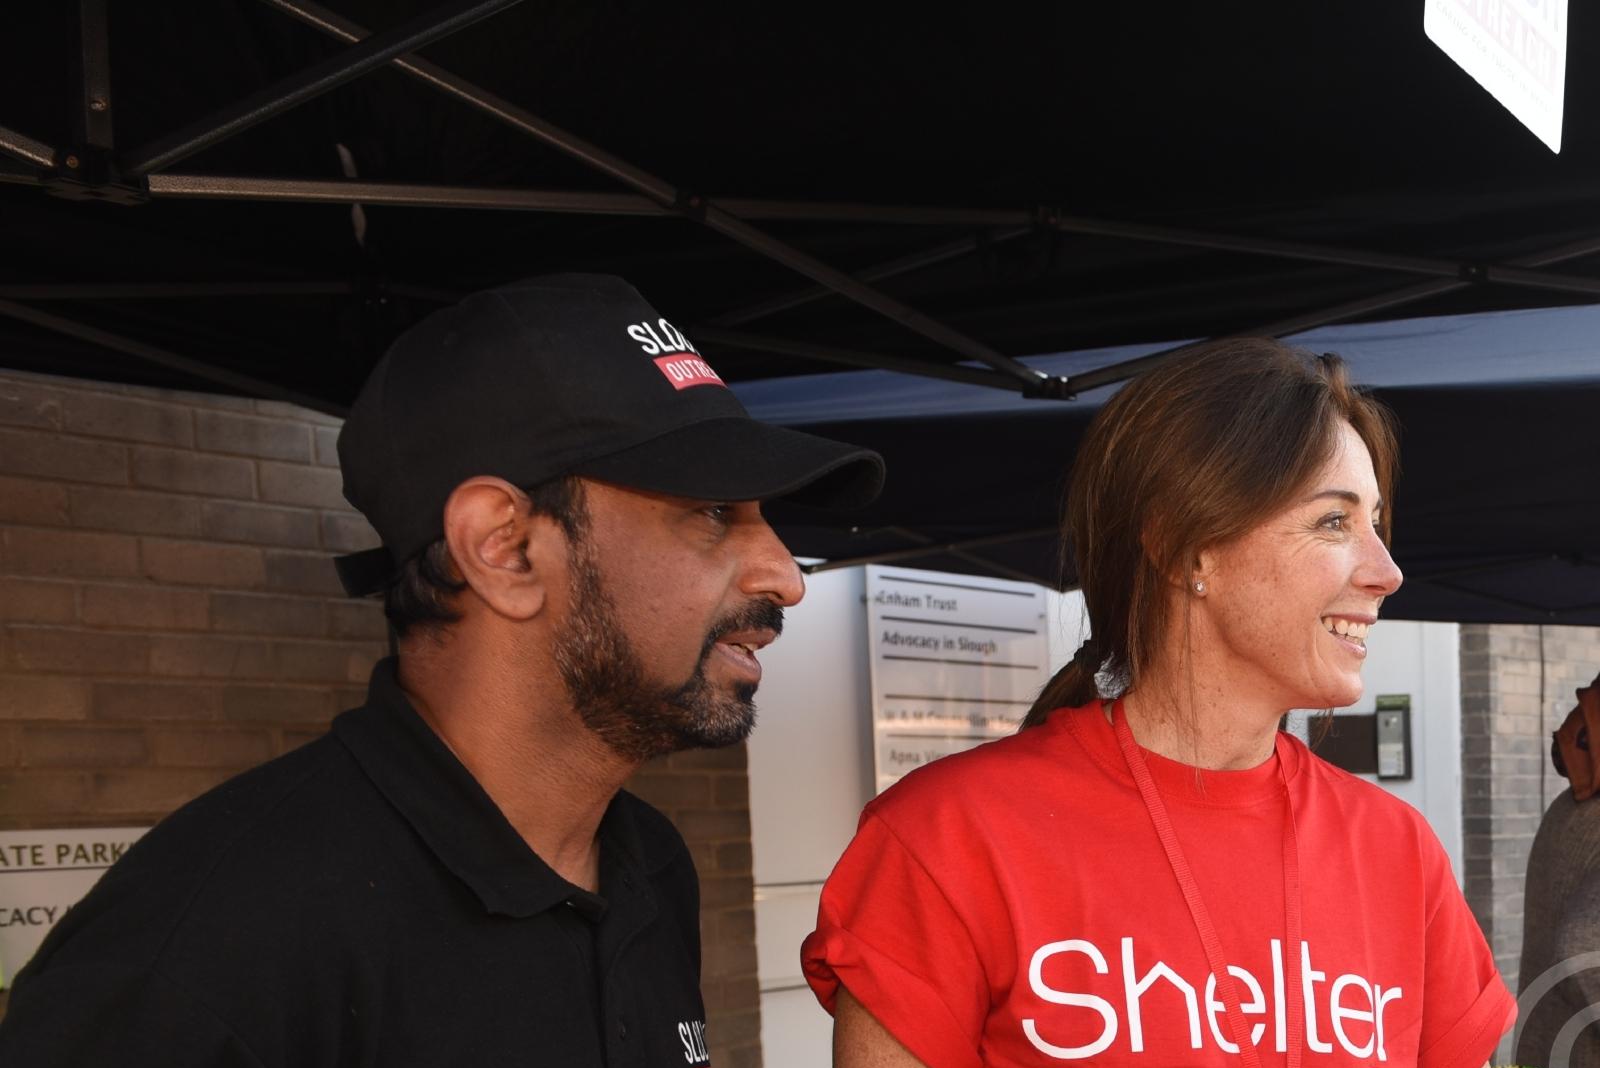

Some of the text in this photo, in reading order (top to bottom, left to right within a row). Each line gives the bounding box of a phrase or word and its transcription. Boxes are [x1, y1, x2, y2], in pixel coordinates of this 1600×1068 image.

[881, 590, 958, 611] Enham Trust
[882, 630, 998, 655] Advocacy in Slough
[1022, 936, 1402, 1062] Shelter
